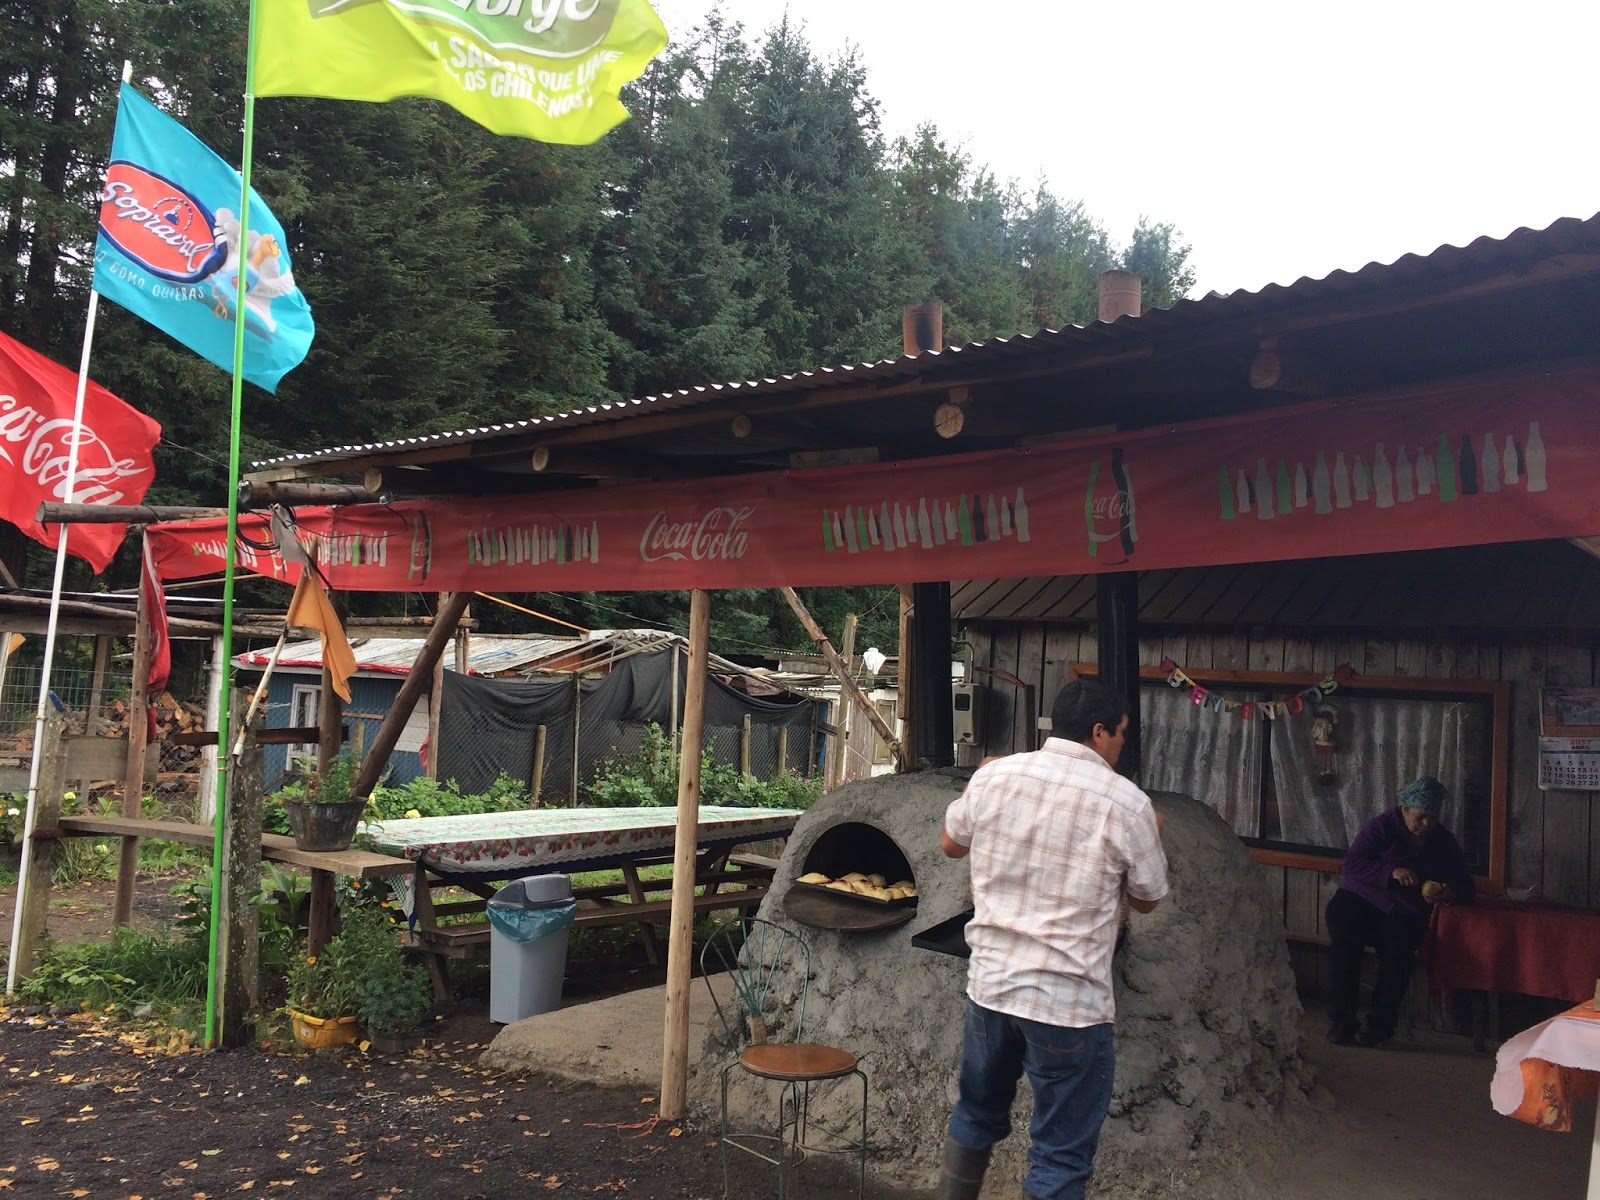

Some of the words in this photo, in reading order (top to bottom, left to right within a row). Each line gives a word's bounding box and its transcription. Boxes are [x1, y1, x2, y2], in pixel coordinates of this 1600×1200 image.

[457, 69, 487, 91] OS
[538, 69, 574, 92] QUE
[101, 181, 215, 273] Sopraval
[109, 262, 145, 290] COMO
[151, 284, 205, 302] QUIERAS
